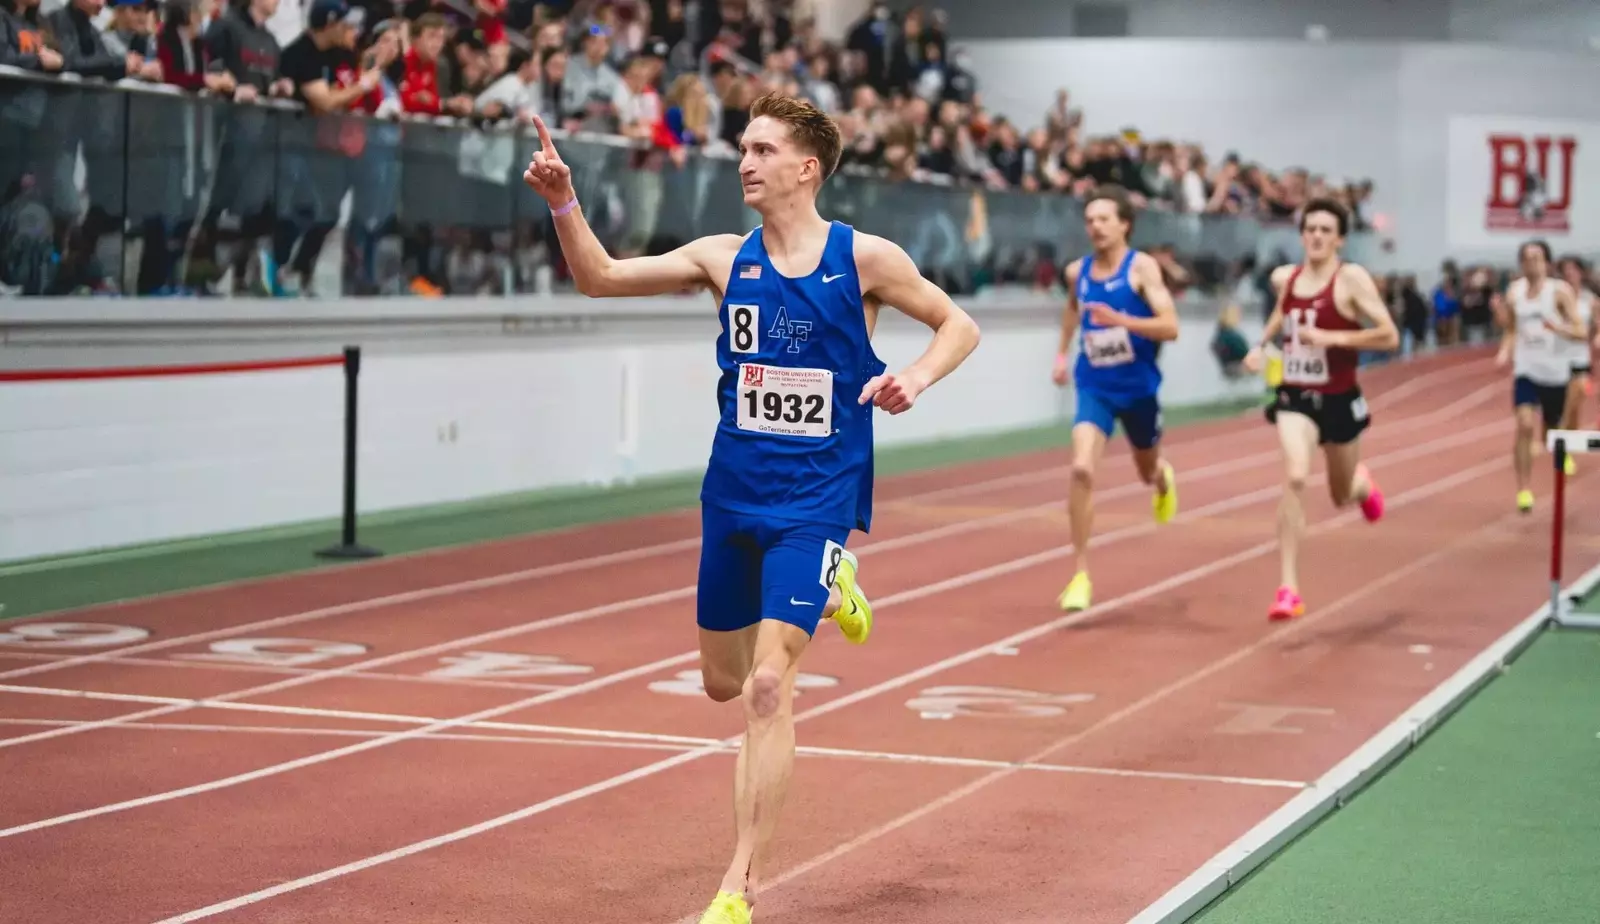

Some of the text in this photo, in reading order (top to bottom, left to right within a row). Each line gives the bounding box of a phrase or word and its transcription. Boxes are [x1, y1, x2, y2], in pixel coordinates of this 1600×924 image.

[1487, 136, 1576, 210] BU
[734, 307, 753, 351] 8
[768, 306, 812, 353] AF
[744, 365, 764, 383] BU
[766, 369, 790, 377] BOSTON
[744, 390, 825, 424] 1932
[759, 424, 807, 435] GoTerriers.com
[826, 547, 841, 589] 8
